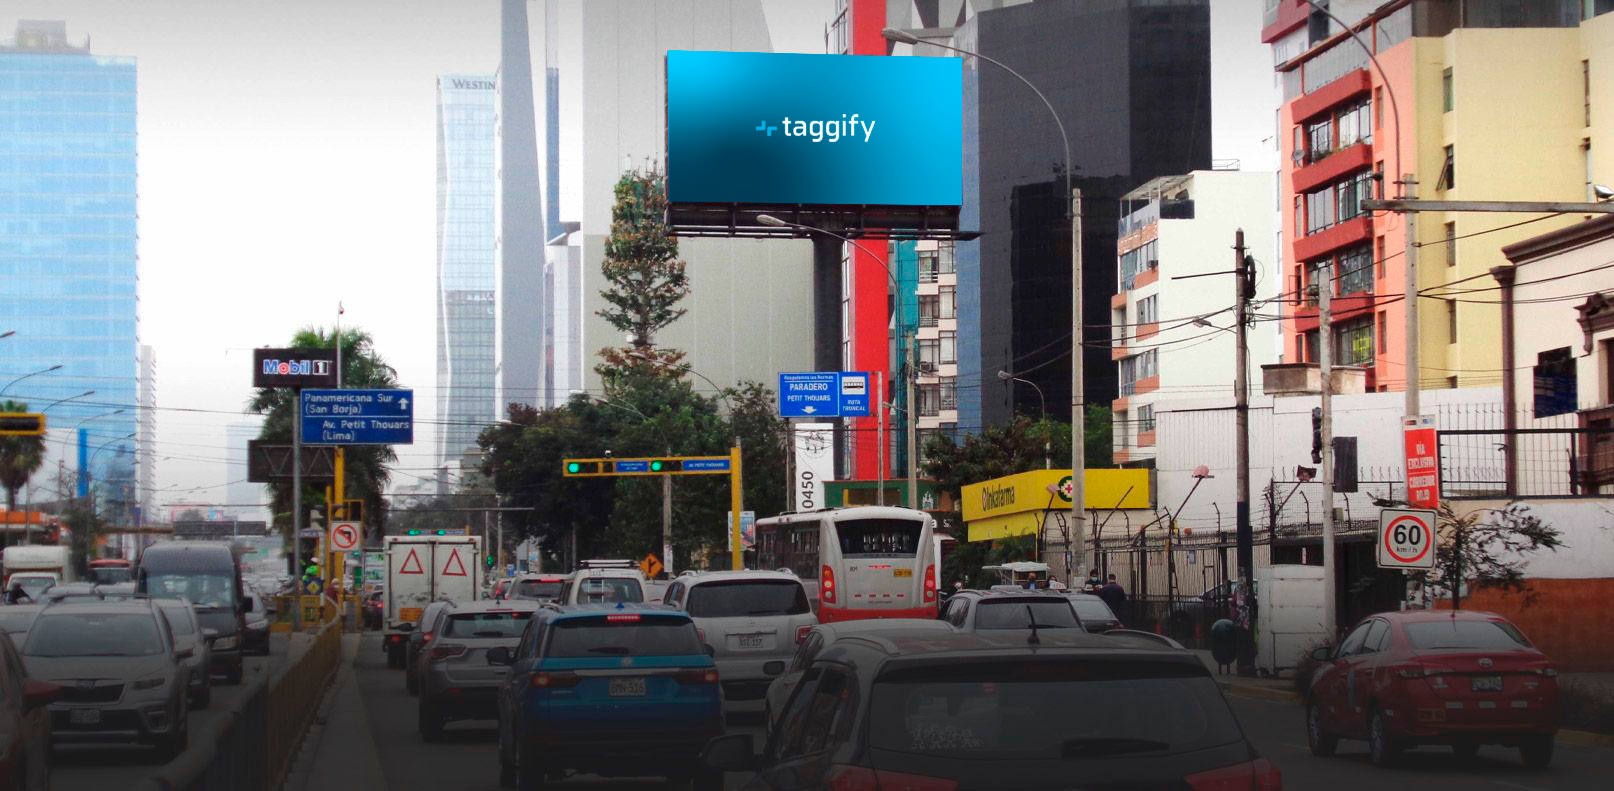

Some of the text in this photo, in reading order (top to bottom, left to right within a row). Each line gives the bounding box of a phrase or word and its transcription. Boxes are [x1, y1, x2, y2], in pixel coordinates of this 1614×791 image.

[783, 113, 876, 142] taggify
[263, 359, 310, 375] Mobil
[789, 383, 828, 391] PARADERO
[305, 393, 393, 402] Panamericana Sur
[787, 394, 831, 402] PETIT THOUARS
[305, 404, 362, 415] (San Borja)
[322, 420, 410, 429] Av. Petit Thouars
[322, 430, 355, 441] (Lima)
[801, 471, 814, 509] 0450
[1394, 524, 1421, 546] 60
